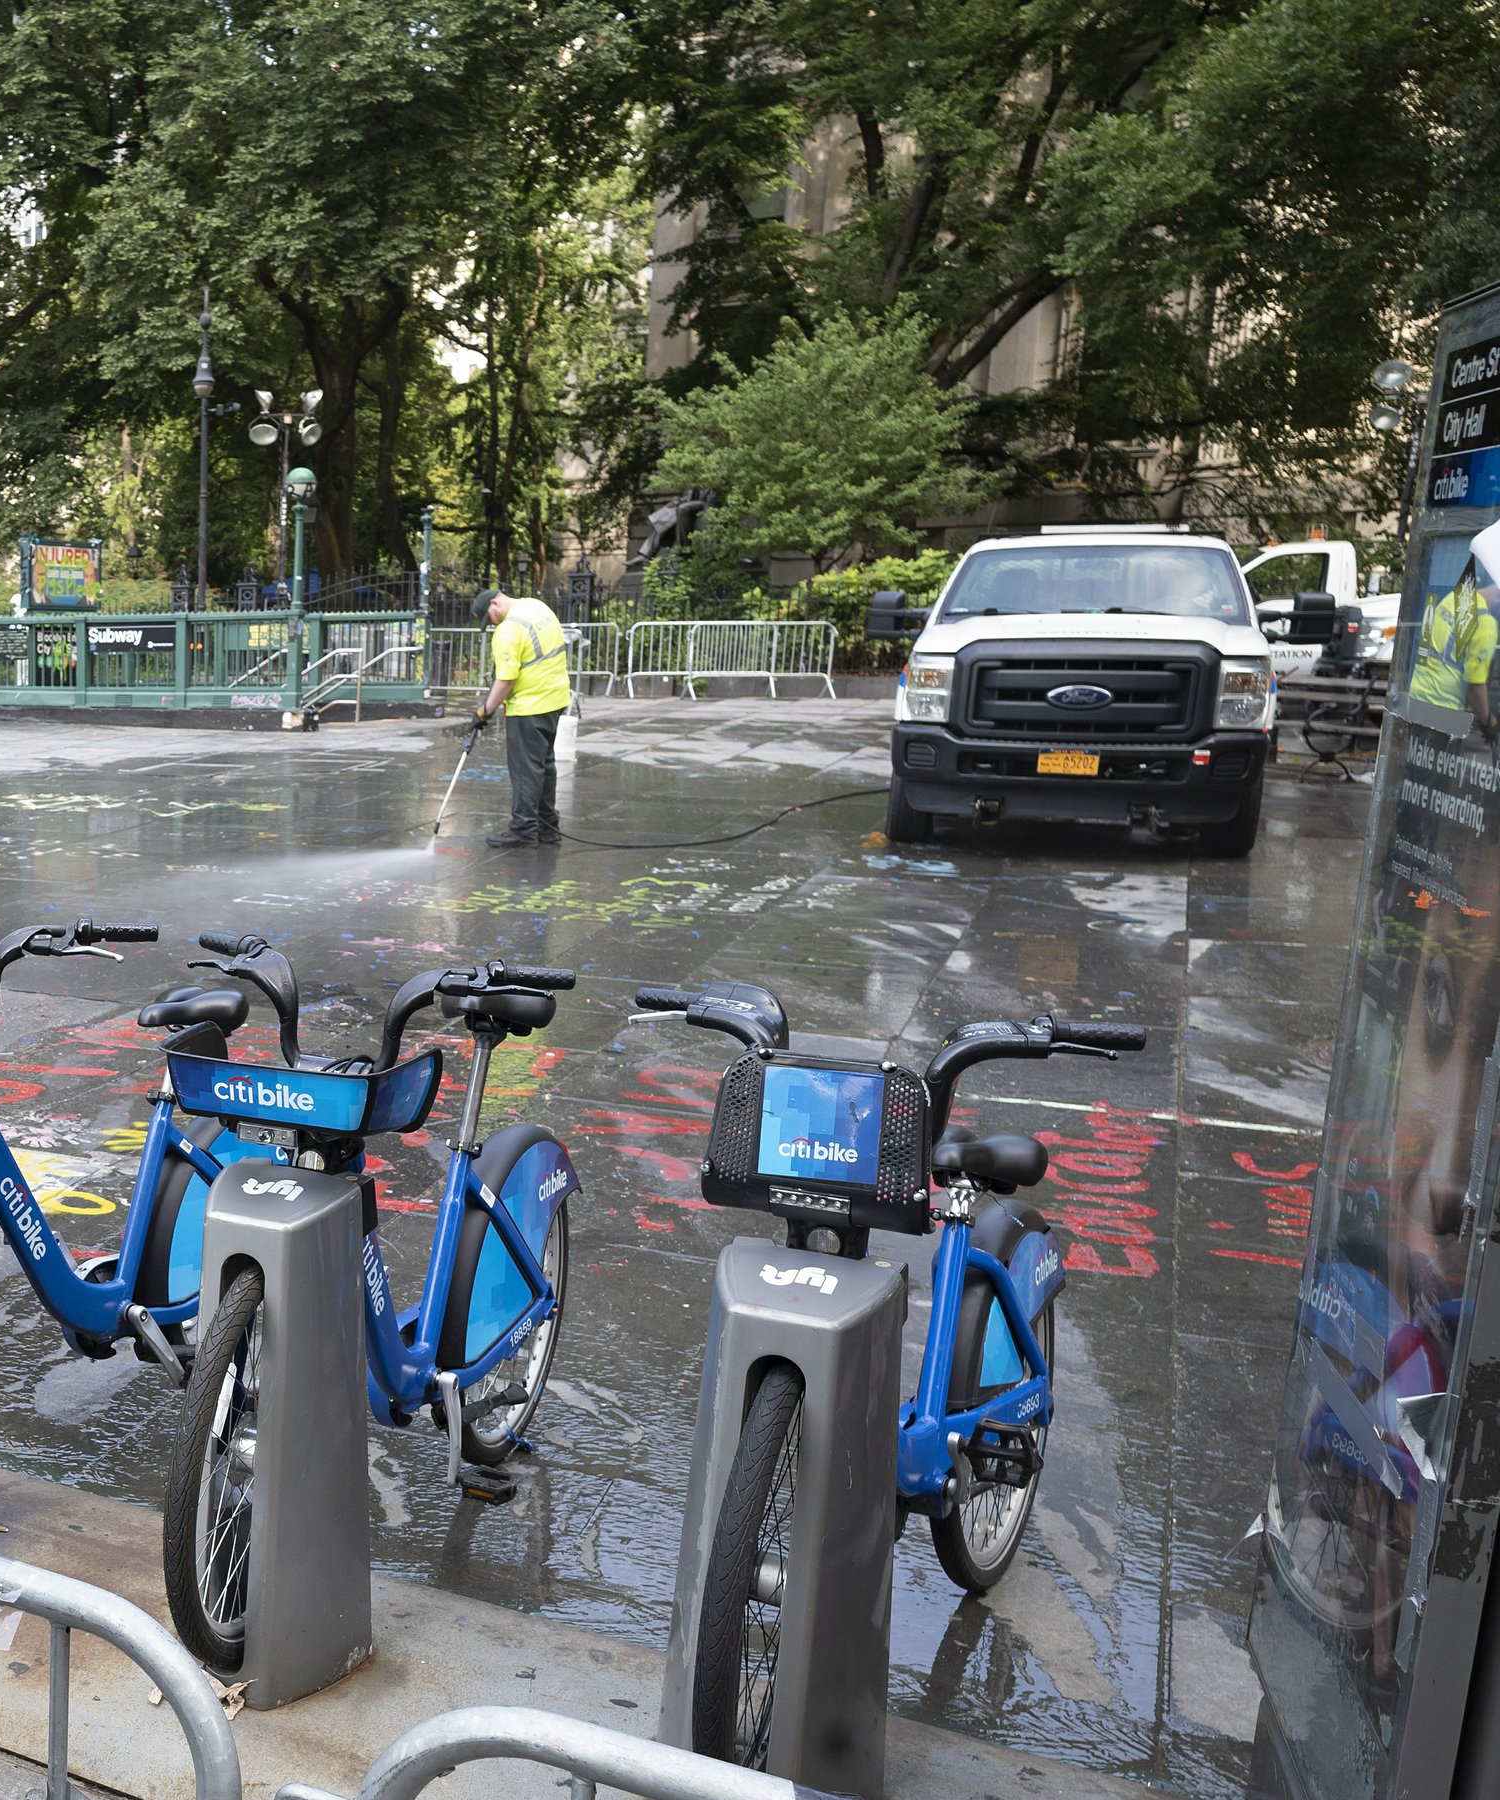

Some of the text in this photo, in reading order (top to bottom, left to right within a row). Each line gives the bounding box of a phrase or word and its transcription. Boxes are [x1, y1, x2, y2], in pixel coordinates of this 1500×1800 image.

[1451, 355, 1485, 388] Centre
[1443, 404, 1487, 447] City Hall
[88, 627, 143, 646] Subway
[1062, 689, 1098, 703] Ford
[1407, 735, 1499, 793] Make every treat
[1401, 778, 1486, 839] more rewarding.
[509, 1317, 533, 1348] 18859
